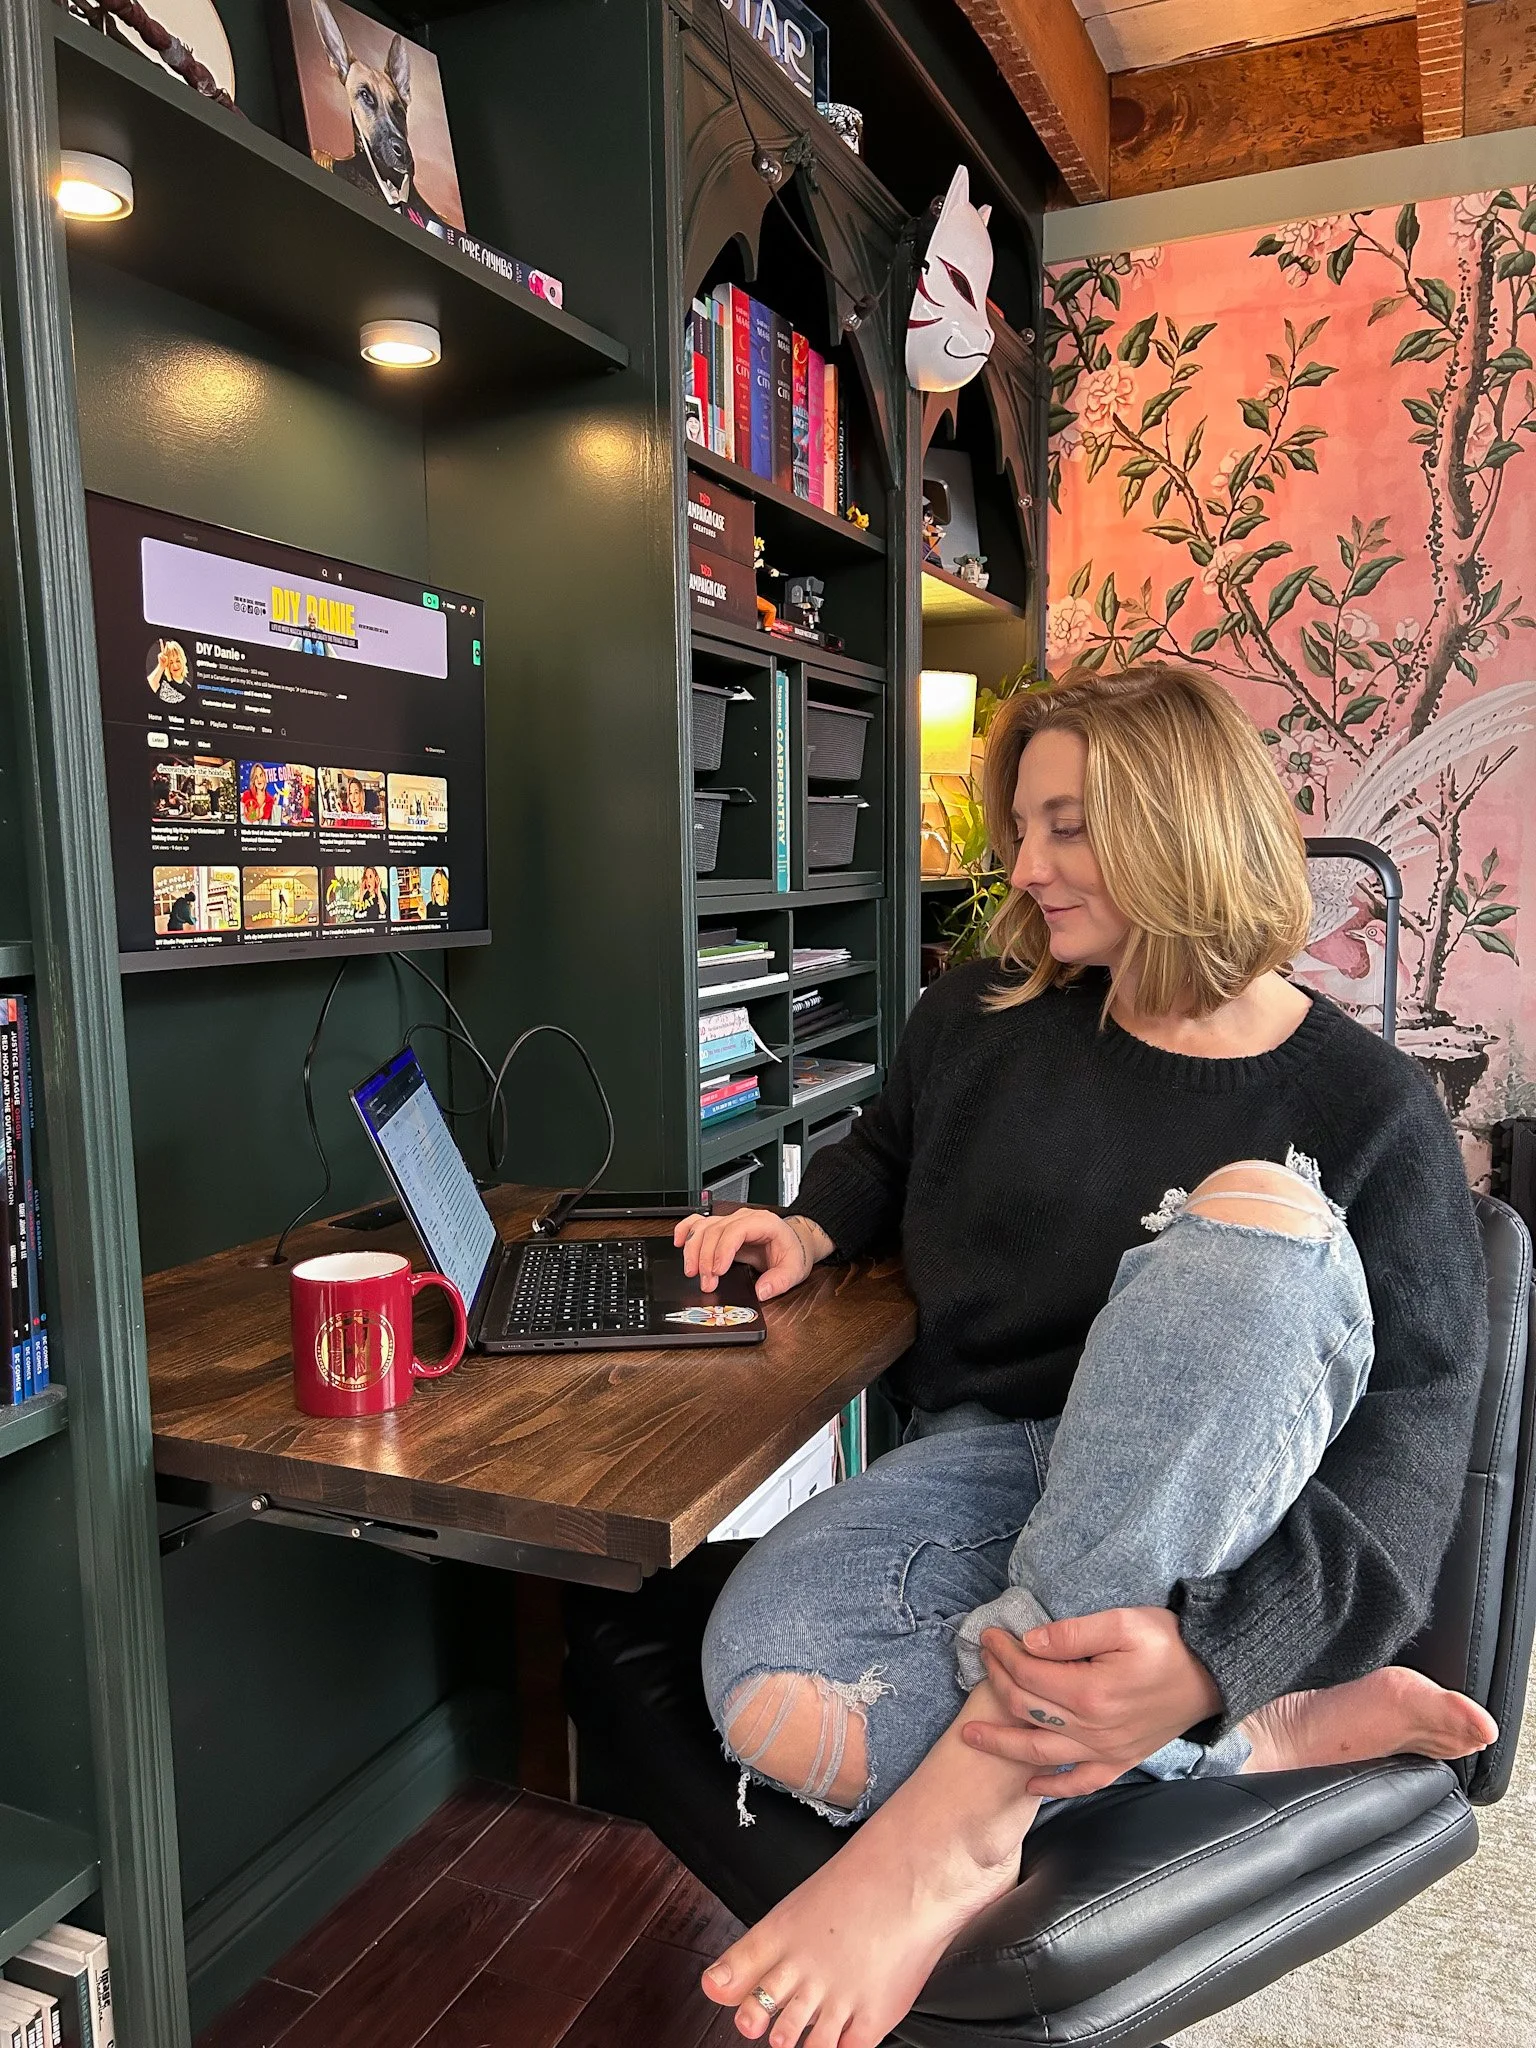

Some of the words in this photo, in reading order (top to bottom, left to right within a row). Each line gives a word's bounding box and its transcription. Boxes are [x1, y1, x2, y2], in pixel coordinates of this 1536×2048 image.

[720, 0, 811, 83] TAR
[736, 364, 750, 380] CITY
[757, 375, 770, 389] CITY
[778, 387, 790, 401] CITY
[688, 501, 712, 526] AMPAIGN
[713, 512, 725, 531] CASE
[693, 523, 716, 538] CREATURES
[689, 573, 714, 597] AMPAIGN
[714, 582, 726, 600] CASE
[271, 586, 301, 625] DIY
[306, 594, 356, 637] DANIE
[196, 641, 213, 656] DIY
[214, 644, 240, 661] Danie
[148, 713, 163, 722] Home
[169, 715, 185, 724] Videos
[190, 718, 205, 727] Shorts
[210, 720, 228, 729] Playlists
[233, 723, 256, 733] Community
[159, 764, 188, 775] decorating
[189, 766, 197, 775] for
[198, 768, 207, 776] the
[208, 767, 230, 777] holidays
[265, 768, 277, 782] THE
[278, 766, 296, 782] GOAL
[776, 728, 786, 845] CARPENTRY
[157, 879, 168, 887] we
[169, 874, 186, 884] need
[155, 884, 174, 896] more
[352, 896, 376, 911] THAT
[1, 1034, 9, 1051] RED
[11, 1031, 19, 1068] JUSTICE
[2, 1052, 10, 1077] HOOD
[3, 1079, 11, 1096] AND
[12, 1070, 20, 1105] LEAGUE
[4, 1115, 12, 1154] OUTLAWS
[14, 1329, 19, 1338] 1
[24, 1323, 29, 1331] 1
[14, 1352, 20, 1364] DC
[25, 1346, 31, 1356] DC
[101, 1968, 111, 2009] Image
